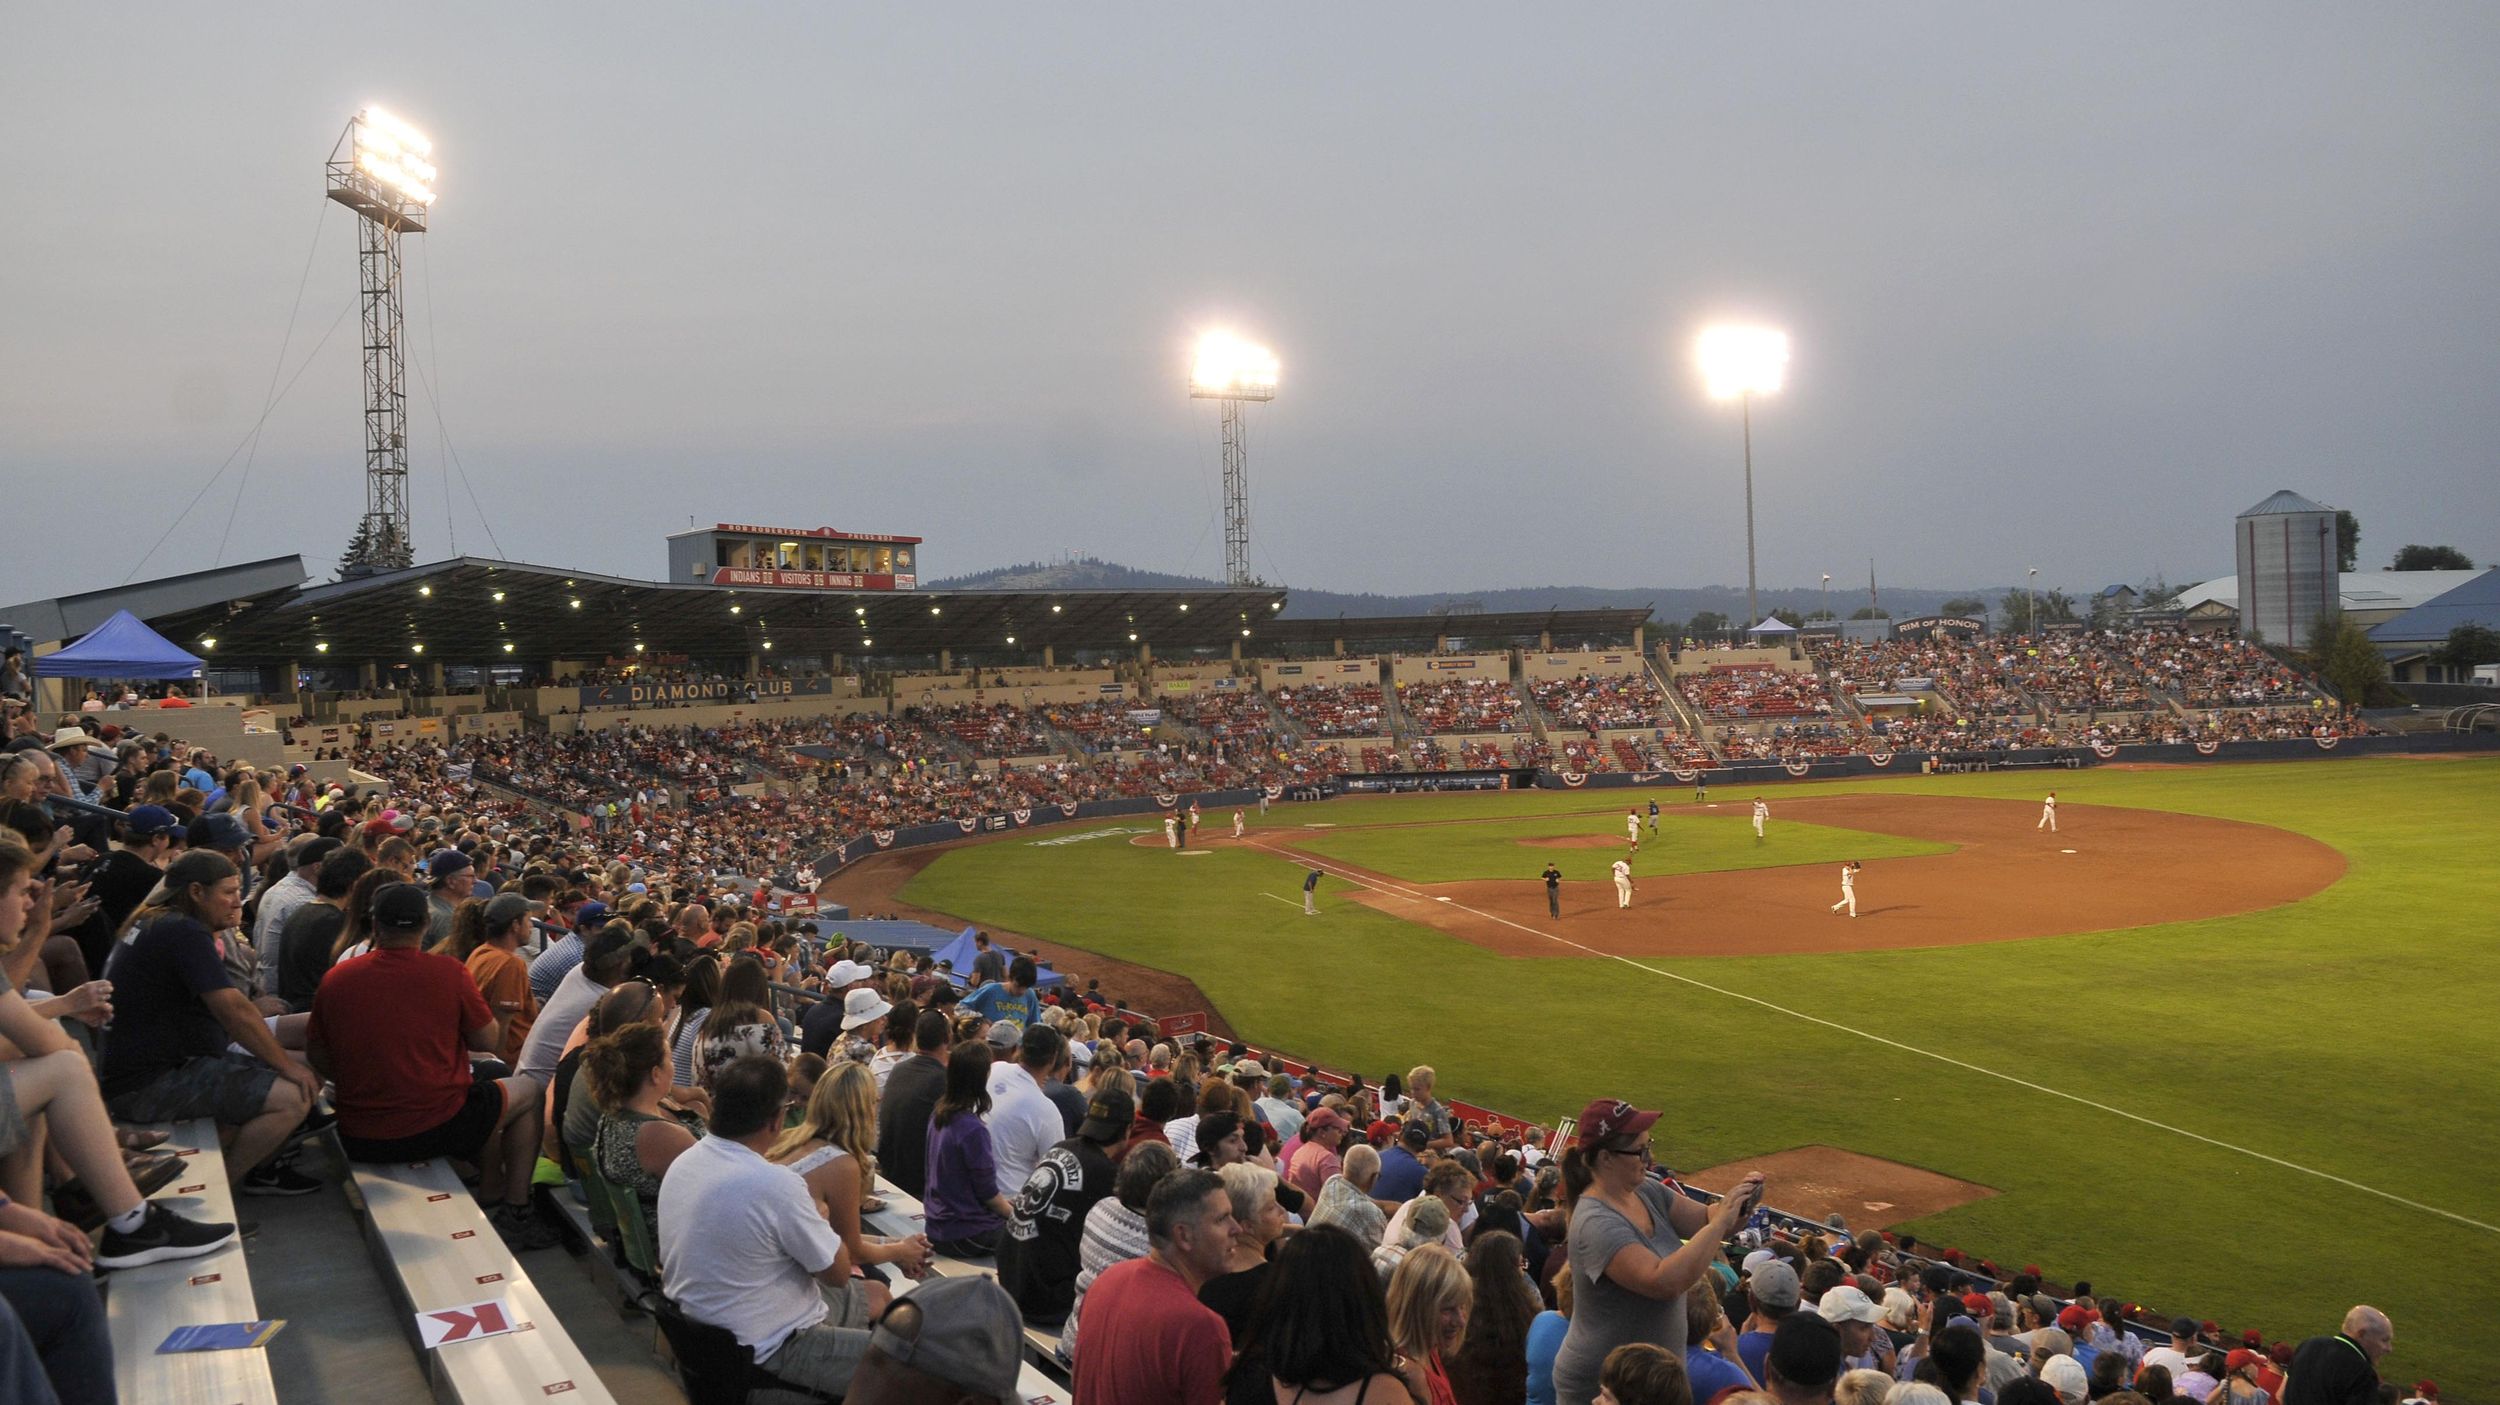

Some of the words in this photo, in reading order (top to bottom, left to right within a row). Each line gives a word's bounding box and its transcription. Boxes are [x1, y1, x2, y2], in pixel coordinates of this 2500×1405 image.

[751, 526, 808, 536] ROBERTSON
[730, 570, 760, 583] INDIANS
[780, 572, 811, 585] VISITORS
[1899, 621, 1920, 633] RIM
[1922, 619, 1936, 627] OF
[1938, 618, 1980, 630] HONOR
[631, 683, 728, 701] DIAMOND
[427, 1302, 509, 1343] K
